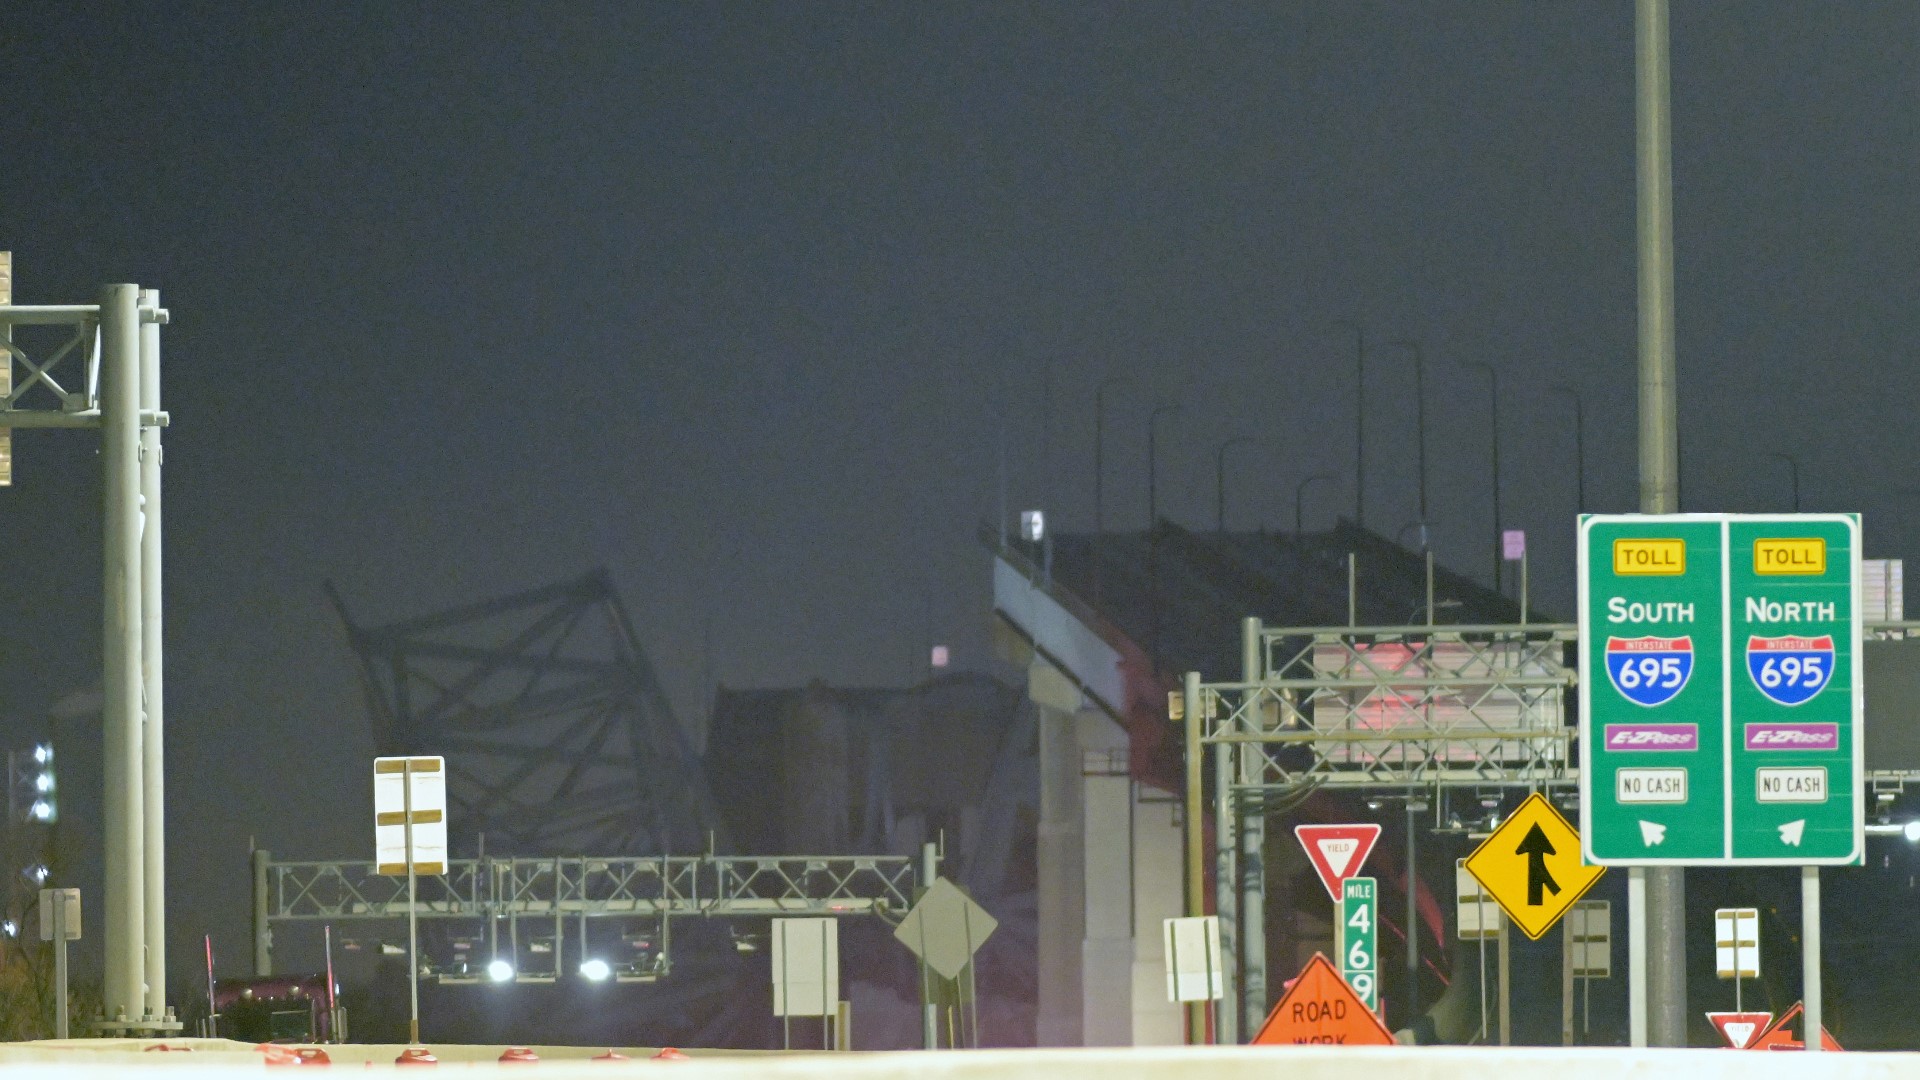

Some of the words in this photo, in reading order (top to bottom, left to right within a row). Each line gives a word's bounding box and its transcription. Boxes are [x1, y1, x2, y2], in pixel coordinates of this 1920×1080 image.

[1623, 549, 1676, 565] TOLL
[1763, 549, 1816, 565] TOLL
[1607, 597, 1694, 622] SOUTH
[1746, 597, 1834, 622] NORTH
[1625, 641, 1673, 650] INTERSTATE
[1767, 640, 1815, 650] INTERSTATE
[1619, 658, 1682, 688] 695
[1761, 657, 1823, 688] 695
[1624, 779, 1641, 793] NO
[1648, 778, 1680, 793] CASH
[1763, 778, 1781, 792] NO
[1788, 778, 1820, 792] CASH
[1327, 844, 1349, 852] YIELD
[1347, 885, 1371, 898] MILE
[1293, 1000, 1346, 1022] ROAD
